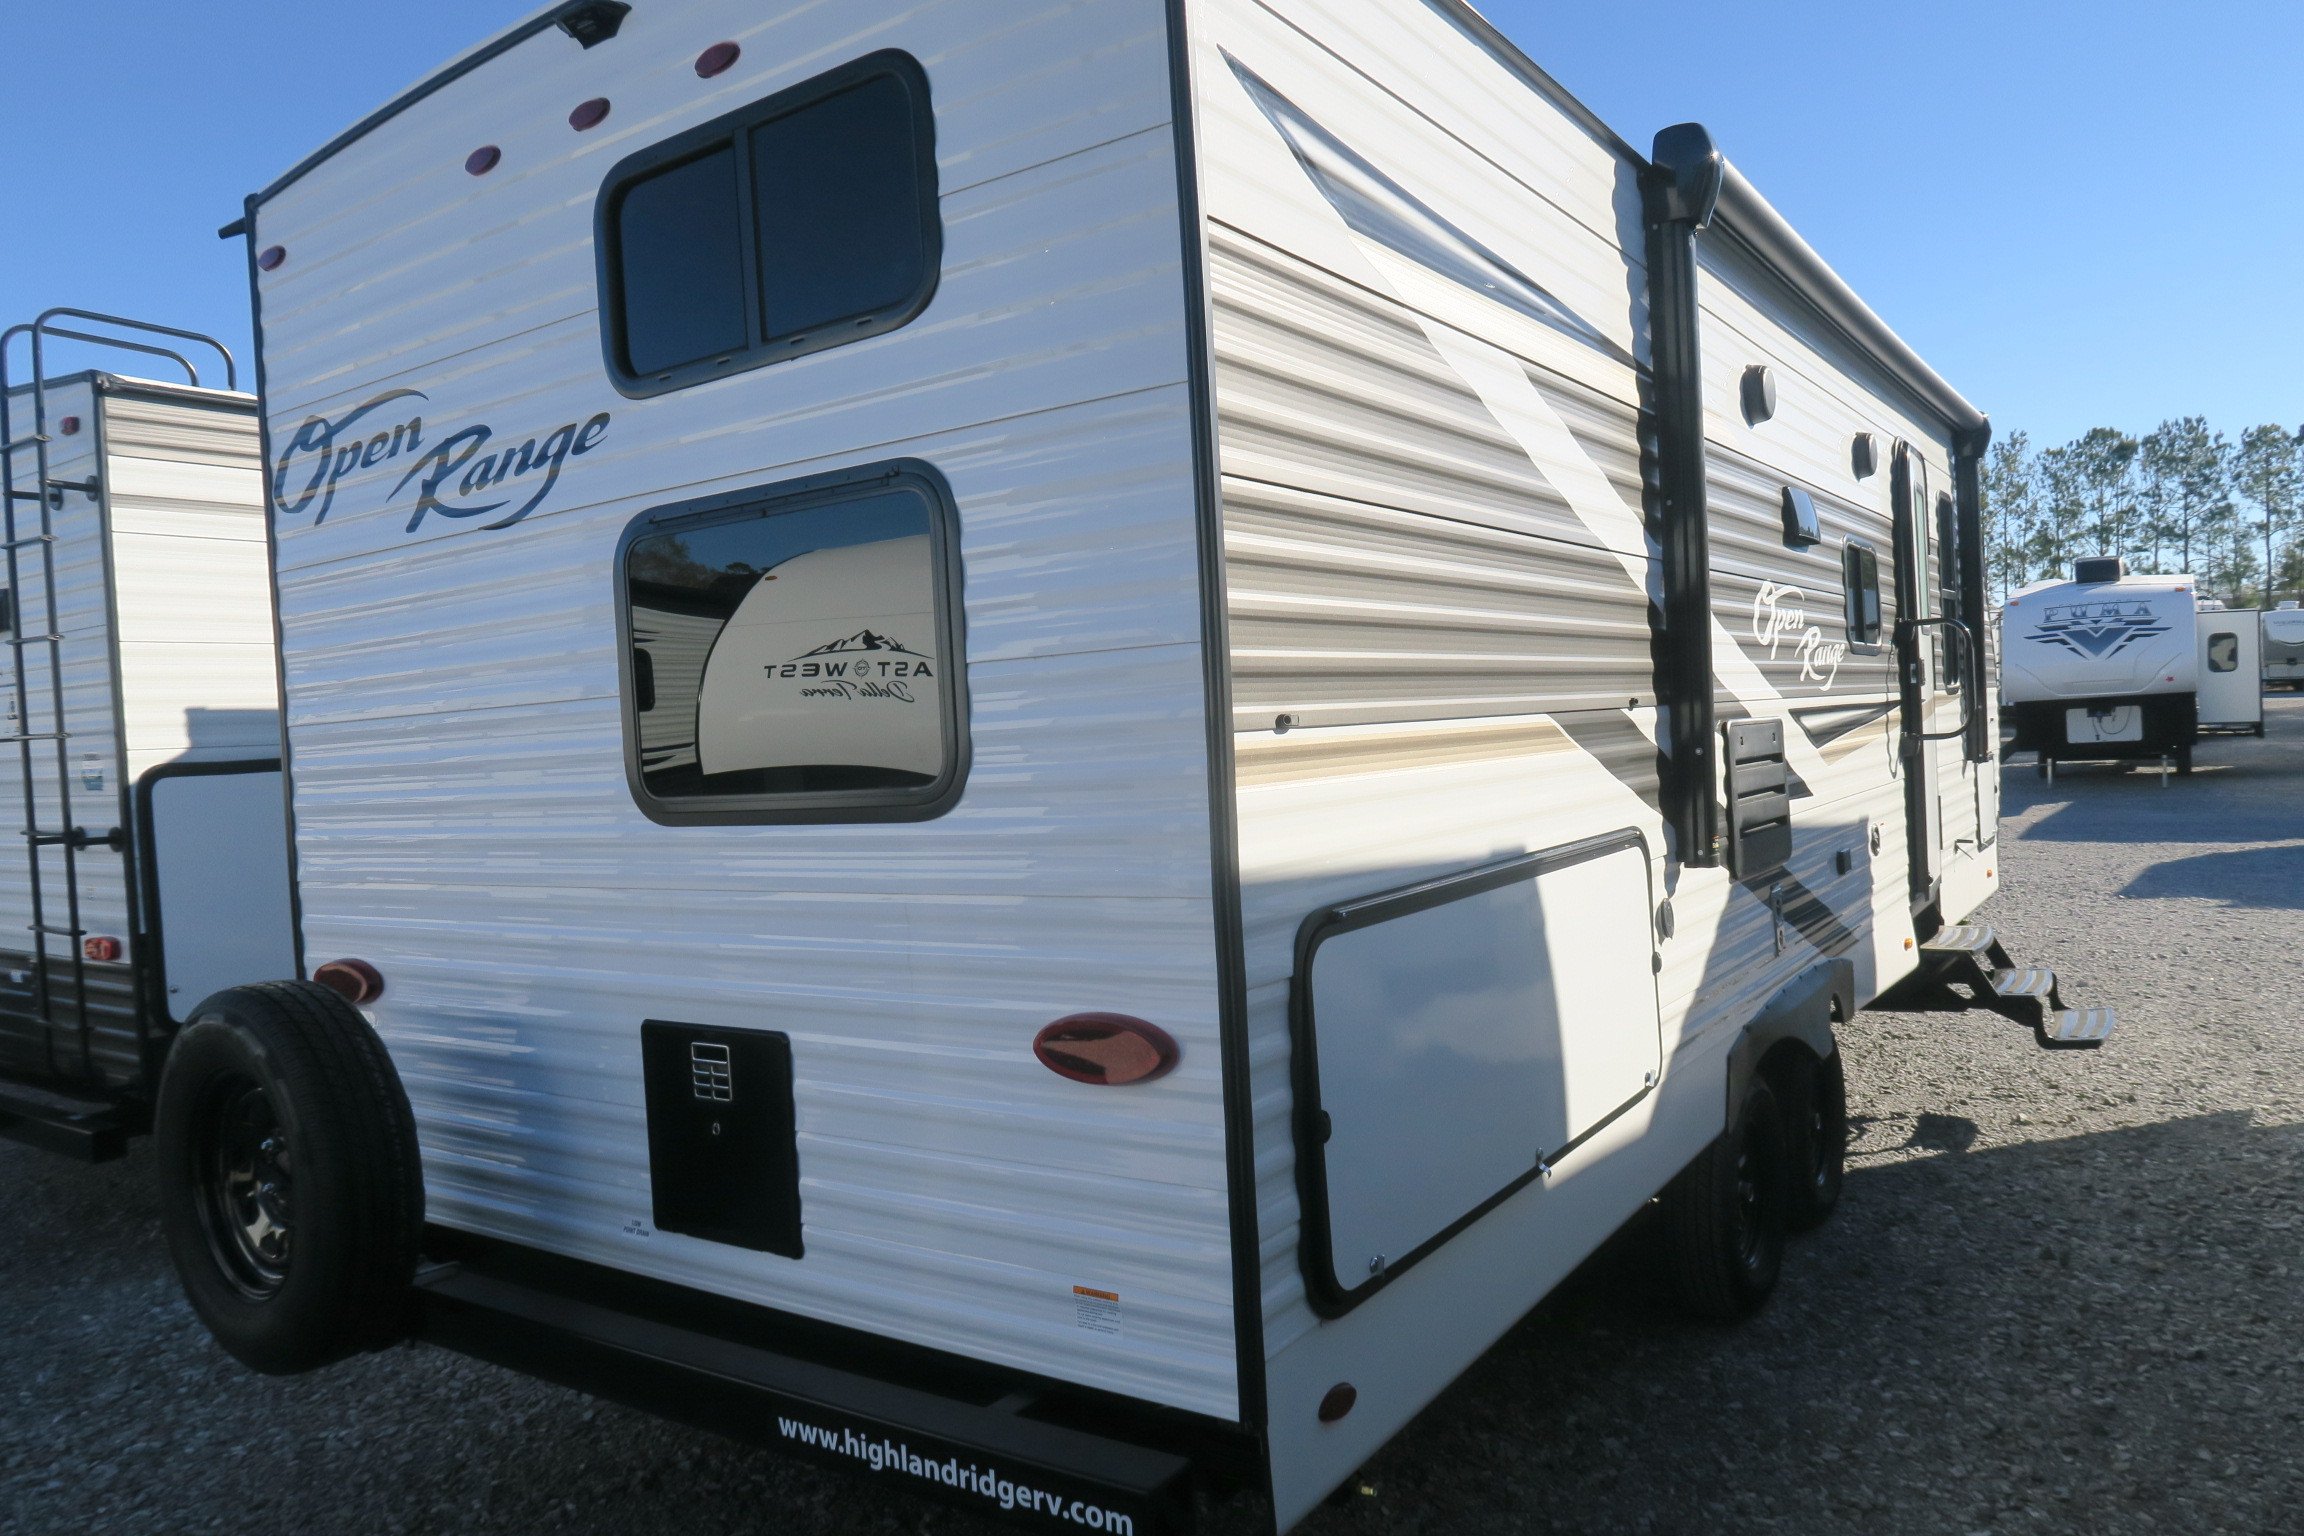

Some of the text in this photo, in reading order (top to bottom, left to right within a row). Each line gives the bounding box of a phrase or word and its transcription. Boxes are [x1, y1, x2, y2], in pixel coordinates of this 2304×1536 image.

[273, 388, 612, 534] Open Range
[1753, 580, 1846, 692] Open Range
[2043, 602, 2152, 623] PUMA
[777, 1416, 1133, 1536] www.highlandridgerv.com
